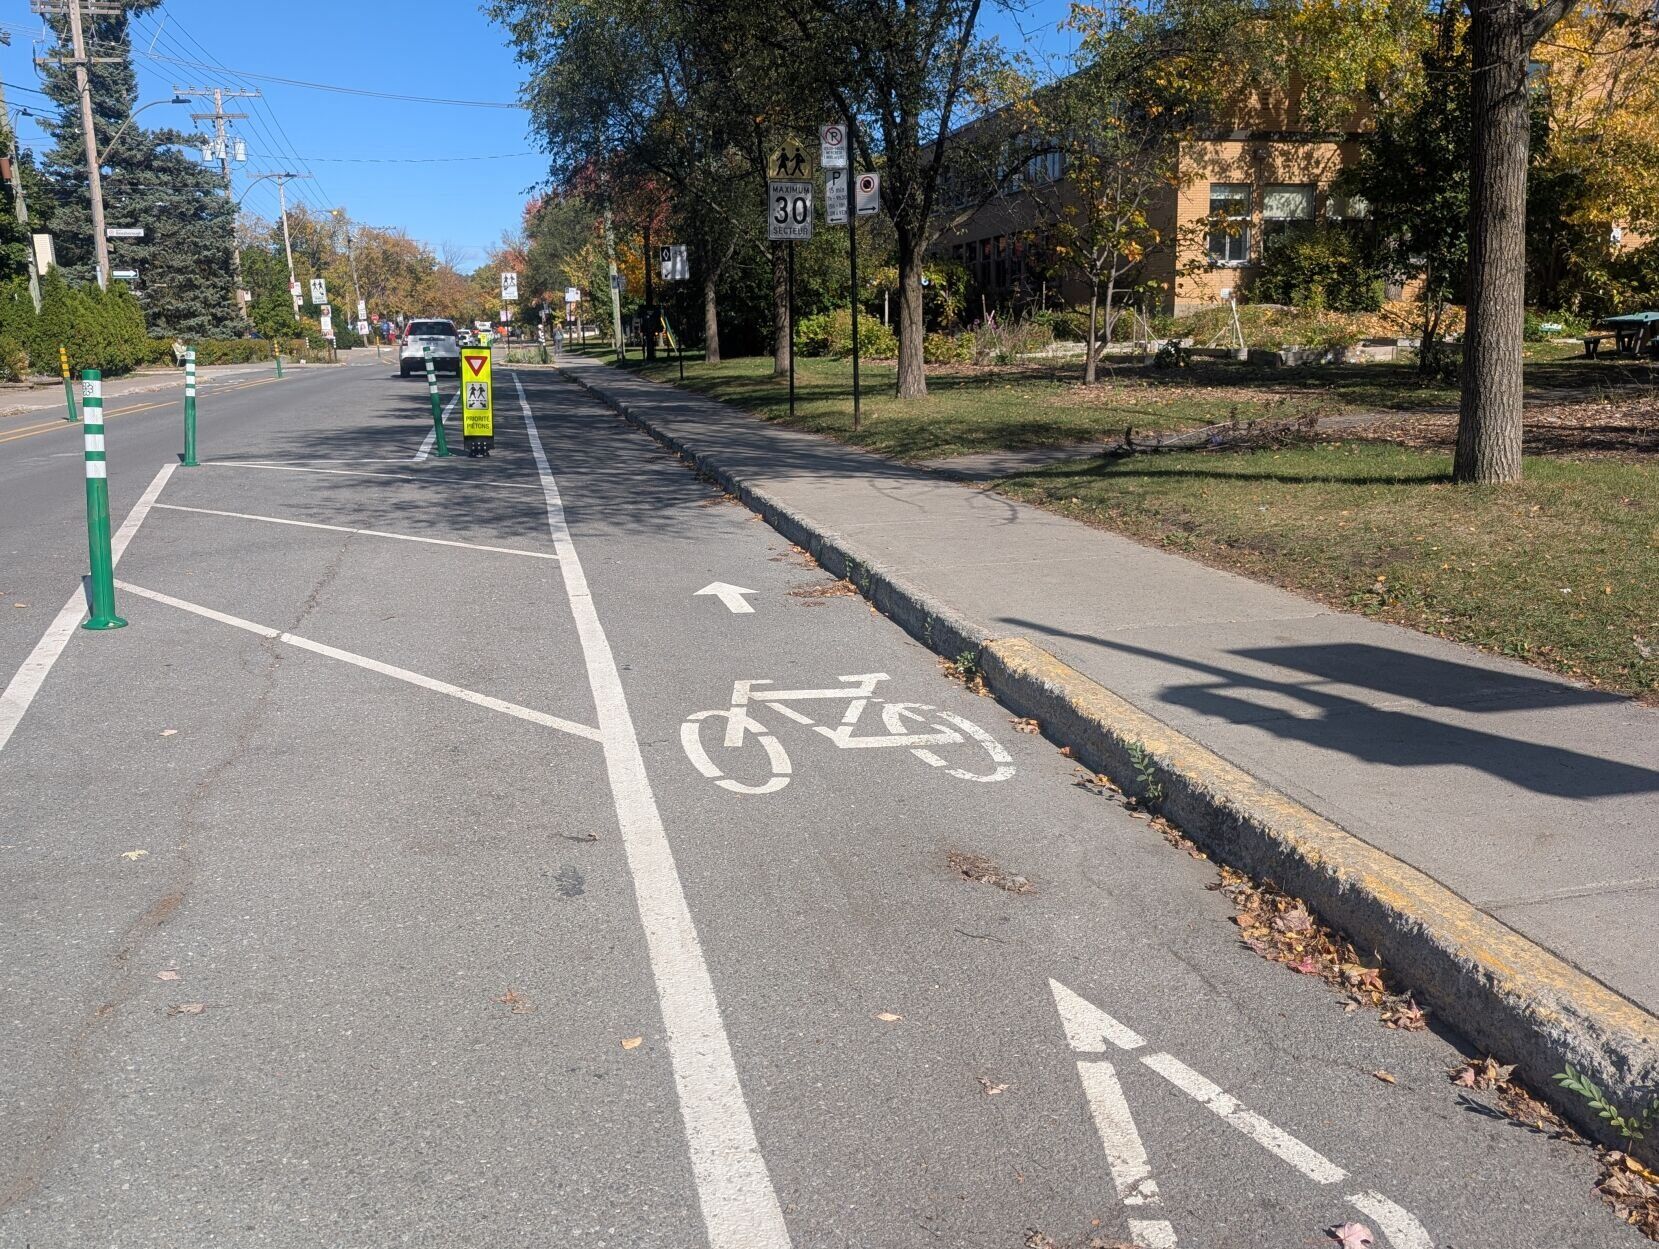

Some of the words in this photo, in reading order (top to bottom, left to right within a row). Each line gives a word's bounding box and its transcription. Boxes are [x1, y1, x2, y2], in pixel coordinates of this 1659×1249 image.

[832, 171, 841, 186] P
[772, 185, 810, 194] MAXIMUM
[774, 196, 808, 225] 30
[773, 226, 809, 235] SECTEUR
[466, 422, 490, 430] PIÉTONS
